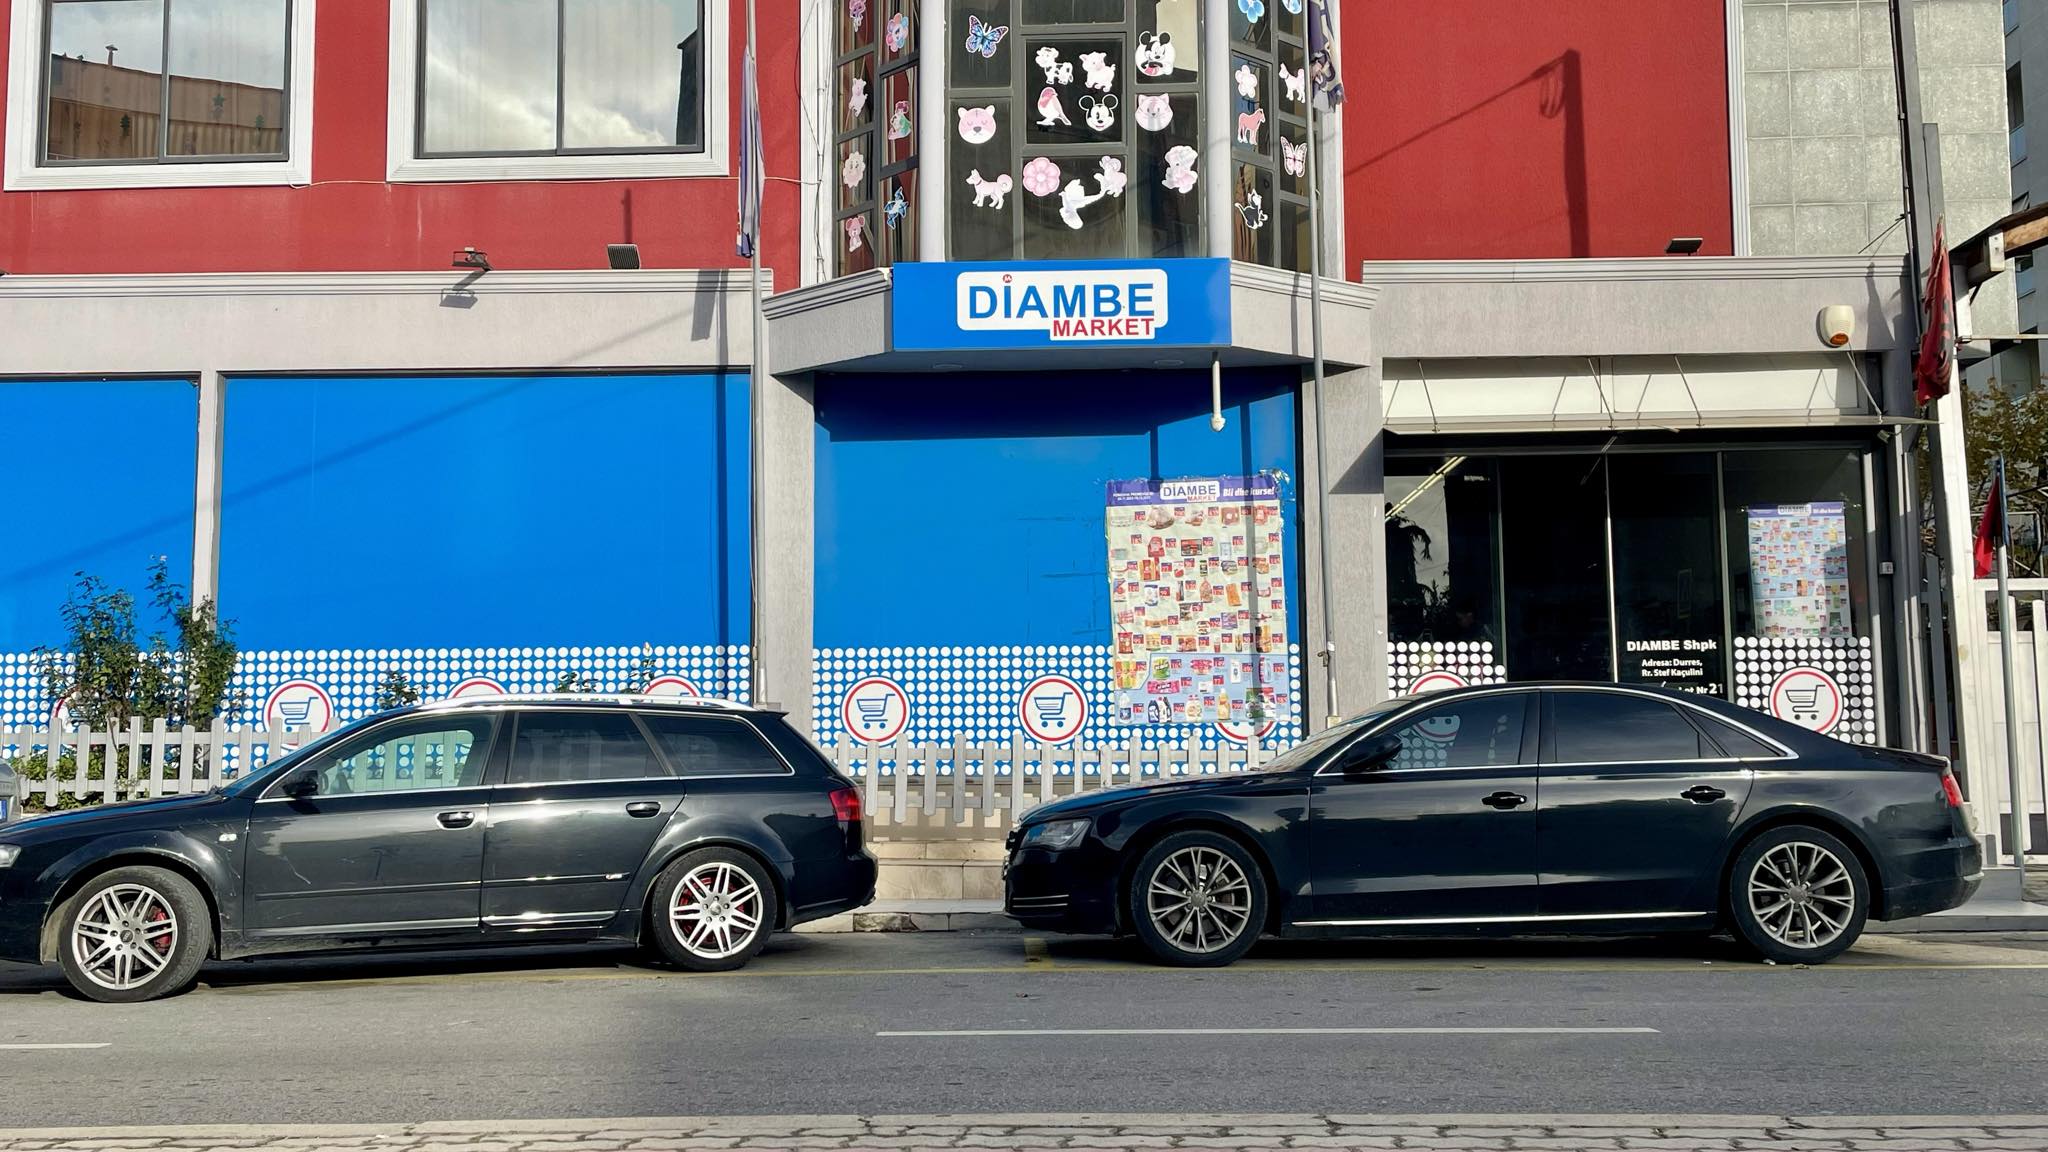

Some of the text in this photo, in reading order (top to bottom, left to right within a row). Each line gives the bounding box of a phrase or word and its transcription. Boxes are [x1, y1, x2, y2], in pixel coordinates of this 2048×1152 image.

[1053, 318, 1155, 337] MARKET
[1234, 487, 1249, 496] dhe
[1626, 639, 1717, 652] DIAMBE Shpk
[1641, 659, 1672, 667] Adresa:
[1641, 668, 1703, 678] Rr. Stef Kaçulini
[1696, 686, 1708, 694] Nr
